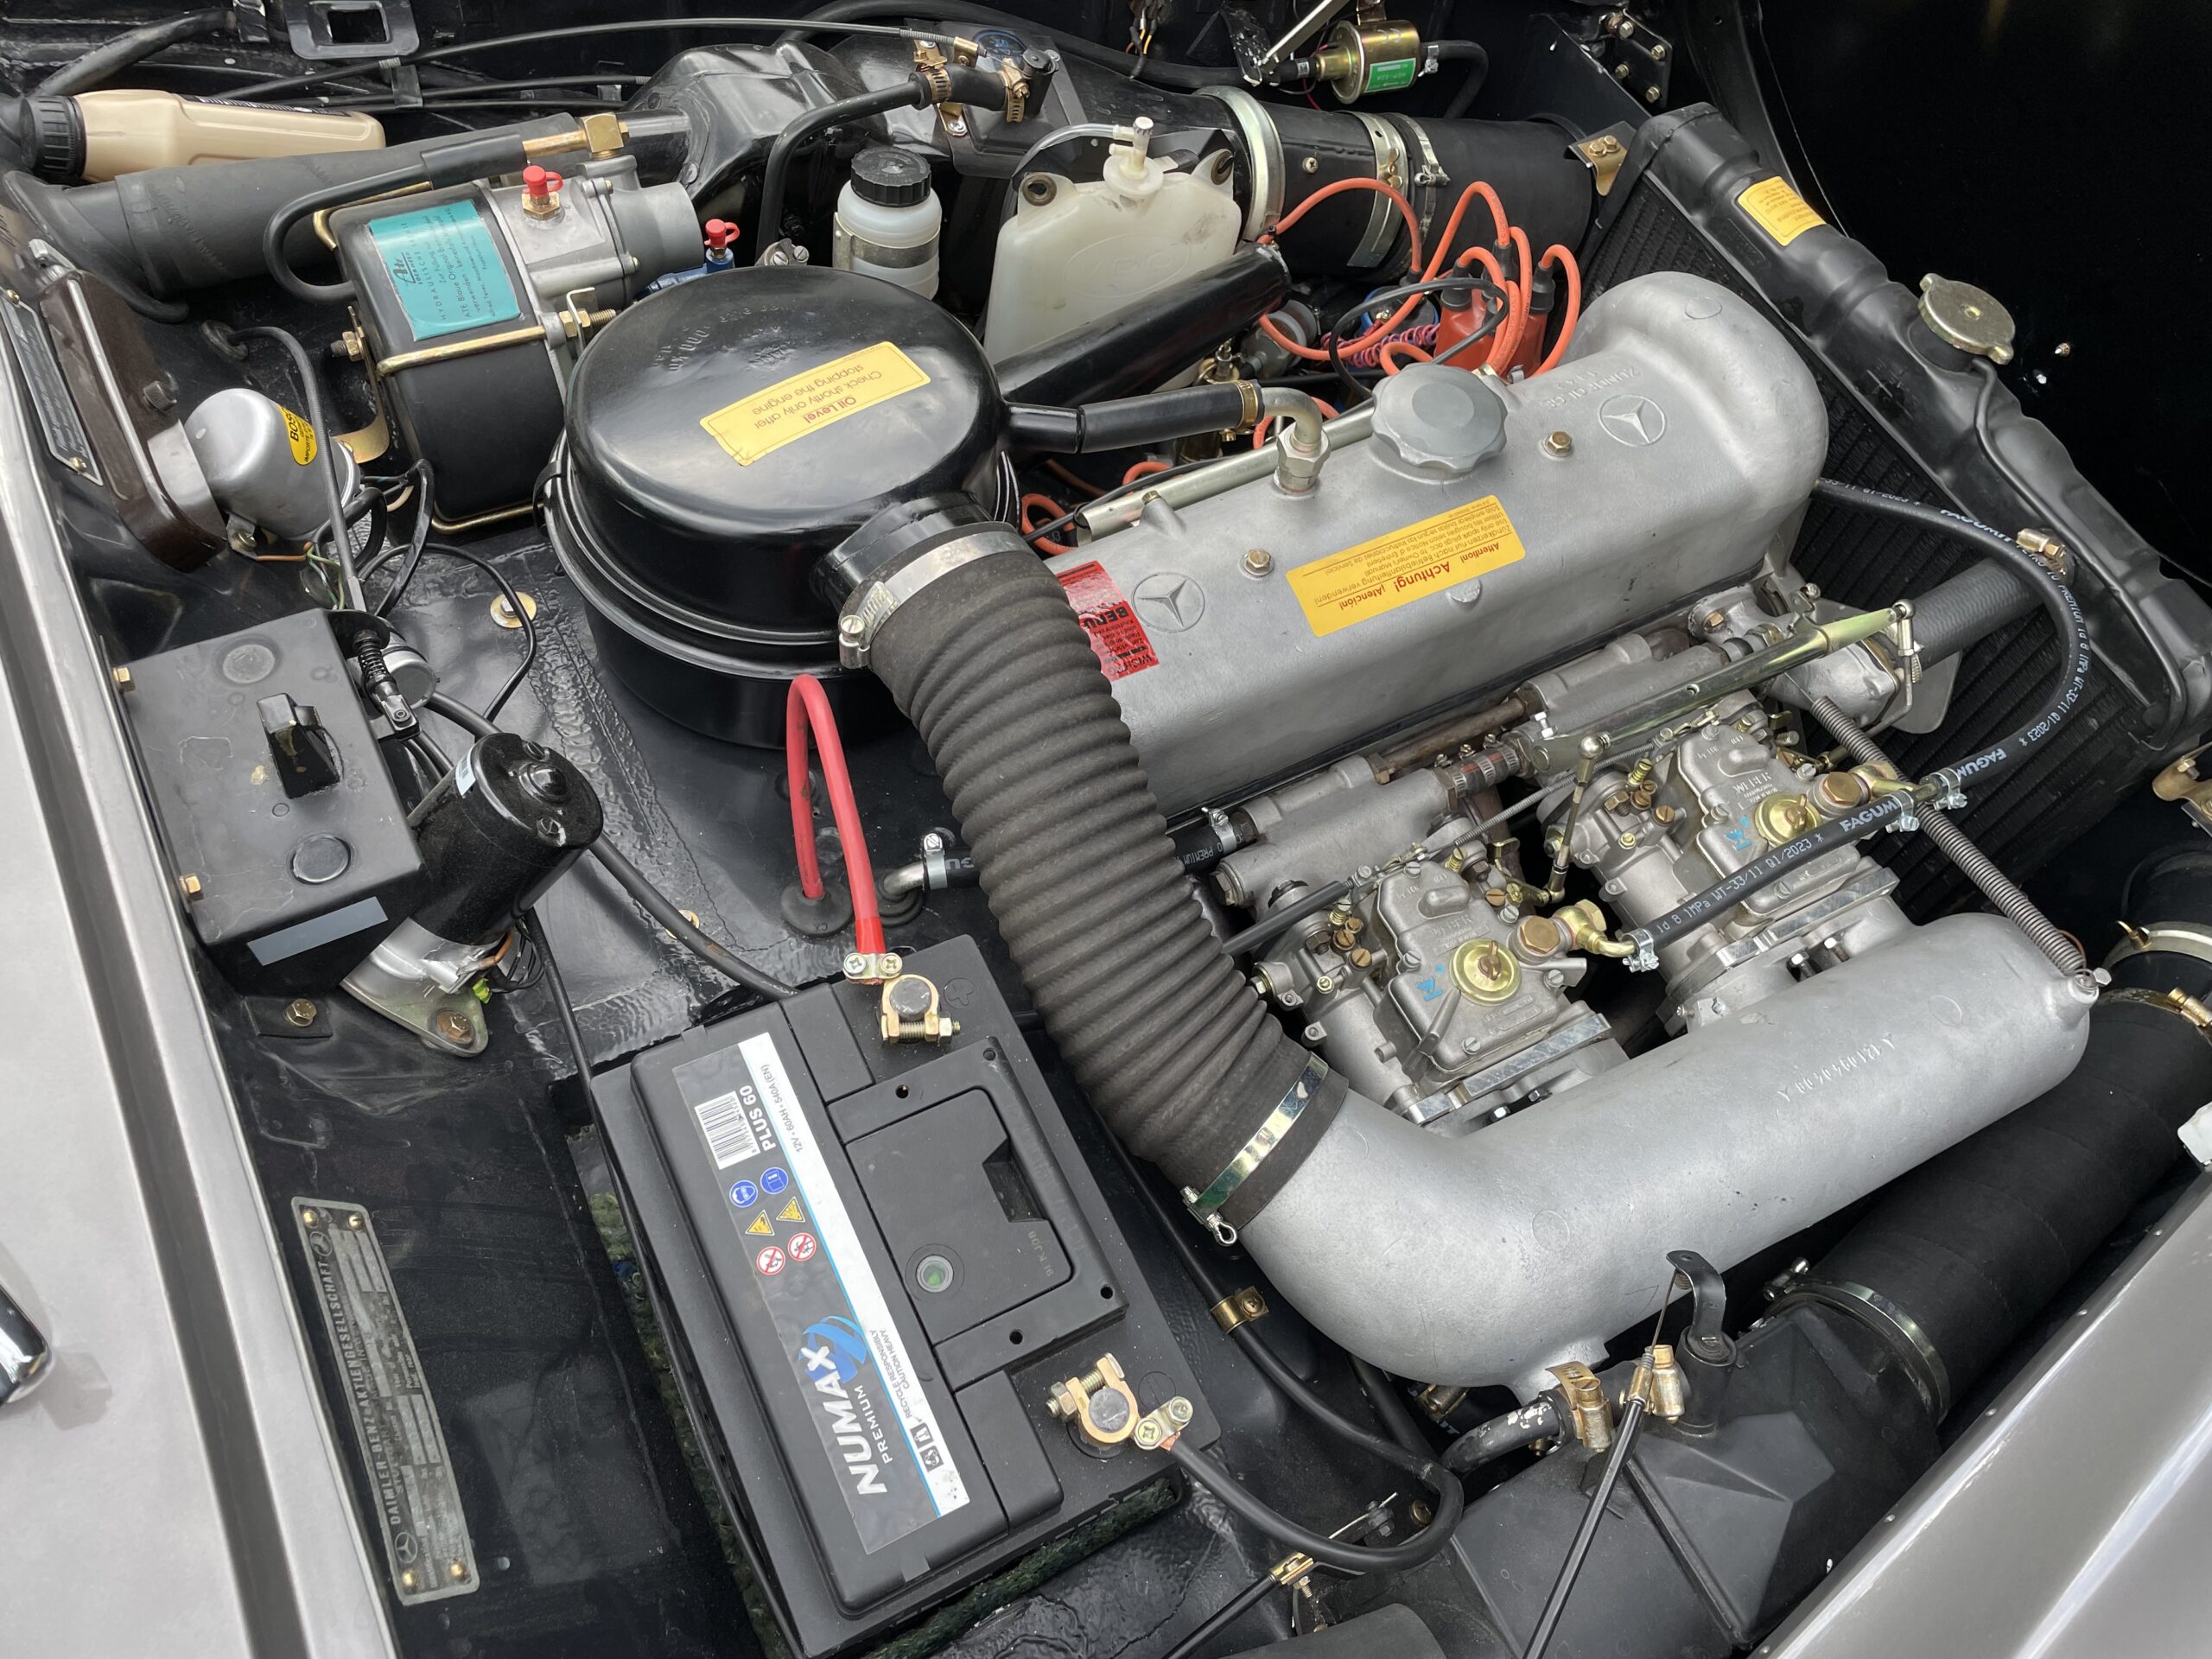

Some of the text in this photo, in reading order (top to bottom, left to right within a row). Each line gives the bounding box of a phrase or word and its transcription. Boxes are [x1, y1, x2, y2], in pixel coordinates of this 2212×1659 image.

[461, 303, 471, 318] ATE
[751, 359, 863, 417] stopping the engine
[753, 366, 882, 430] Check shortly only after
[803, 393, 856, 424] Oil Level
[1432, 545, 1454, 560] nach
[1460, 524, 1479, 539] spark
[1313, 580, 1361, 605] verwenden!
[1338, 541, 1500, 611] Attention! Achtung! ¡Atención!
[1082, 605, 1128, 631] BERU
[1956, 747, 2007, 778] FAGUM
[1840, 798, 1900, 832] FAGUM
[1672, 915, 1681, 925] 8
[1685, 899, 1711, 918] 1MPa
[1712, 866, 1763, 900] WT-33/11
[1767, 838, 1813, 868] Q1/2023
[738, 1084, 776, 1151] PLUS 60
[759, 1063, 804, 1153] 12V 60AH 540A (EN)
[868, 1327, 913, 1419] RECYCLE RESPONSIBLY
[879, 1327, 910, 1389] CAUTION HEAVY
[800, 1337, 887, 1502] NUMAX
[853, 1383, 893, 1464] PREMIUM
